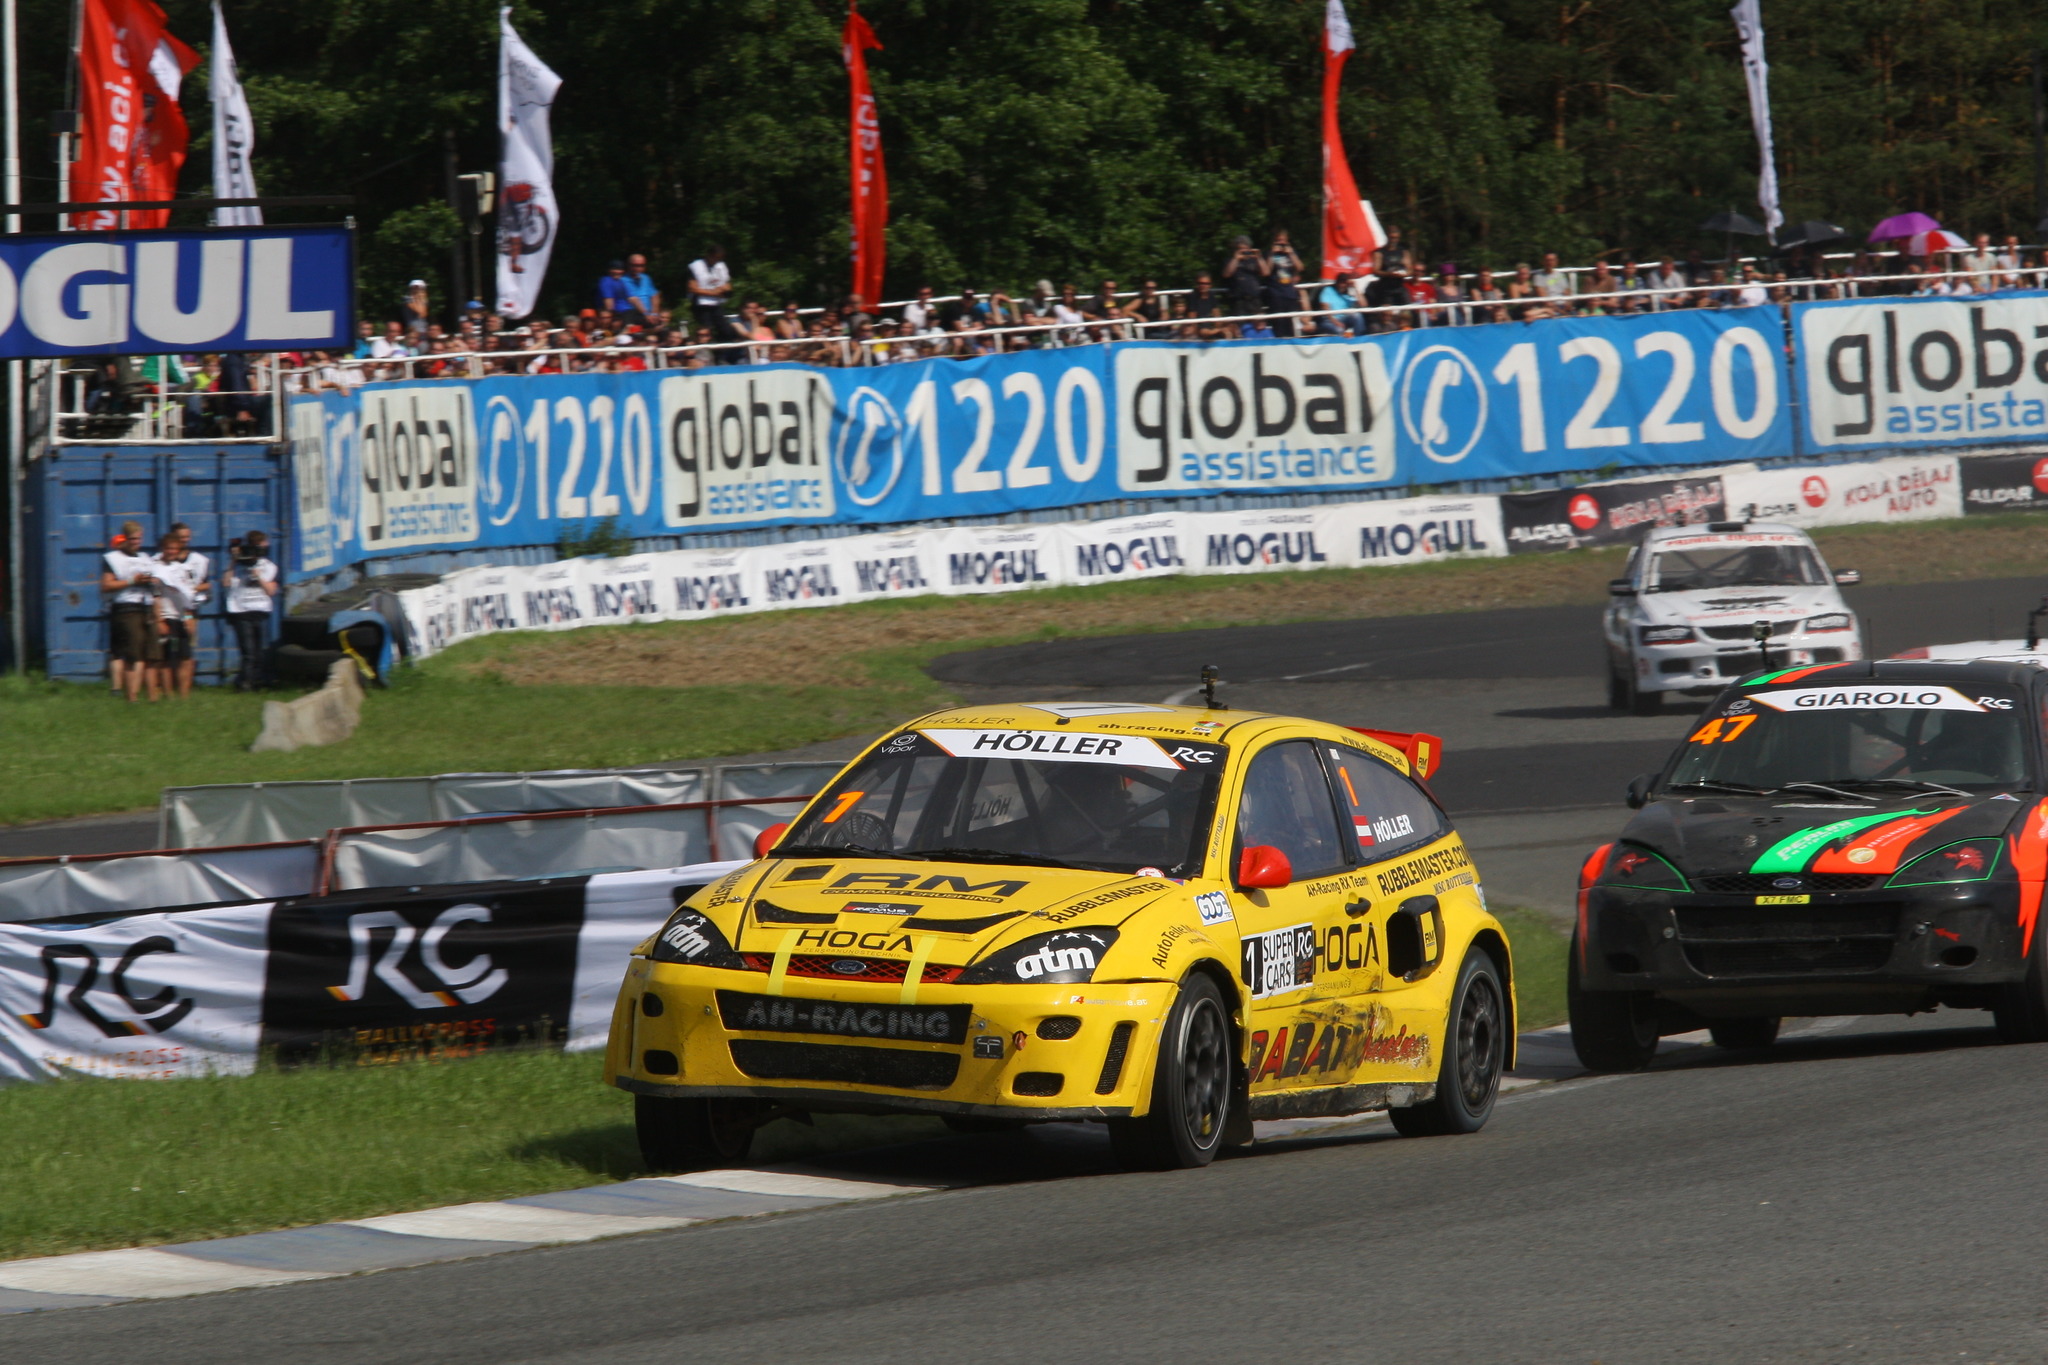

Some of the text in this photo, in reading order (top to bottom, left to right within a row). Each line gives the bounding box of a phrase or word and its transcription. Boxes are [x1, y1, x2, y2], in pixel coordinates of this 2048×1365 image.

[1493, 325, 1778, 453] 1220
[905, 366, 1105, 496] 1220
[1133, 350, 1374, 483] global
[524, 393, 653, 521] 1220
[671, 378, 819, 518] global
[1180, 439, 1377, 482] assistance
[1843, 480, 1893, 507] KOLA
[1887, 487, 1937, 515] AUTO
[1077, 535, 1188, 577] MOGUL
[1207, 530, 1327, 567] MOGUL
[1361, 518, 1487, 560] MOGUL
[949, 549, 1047, 586] MOGUL
[1794, 691, 1942, 708] GIAROLO
[973, 730, 1123, 756] HÖLLER
[1097, 723, 1211, 738] ah-racing.at
[1689, 713, 1758, 745] 47
[822, 791, 865, 823] 1
[1374, 814, 1414, 842] HÖLLER
[823, 888, 908, 896] COMPACT
[1348, 875, 1369, 888] Team
[1049, 882, 1171, 924] RUBBLEMASTER
[796, 929, 913, 953] HOGA
[1263, 930, 1294, 963] SUPER
[1312, 921, 1380, 976] HOGA
[1016, 944, 1095, 979] atm
[1245, 941, 1256, 991] 1
[1265, 960, 1292, 991] CARS
[745, 1000, 950, 1038] AH-RACING
